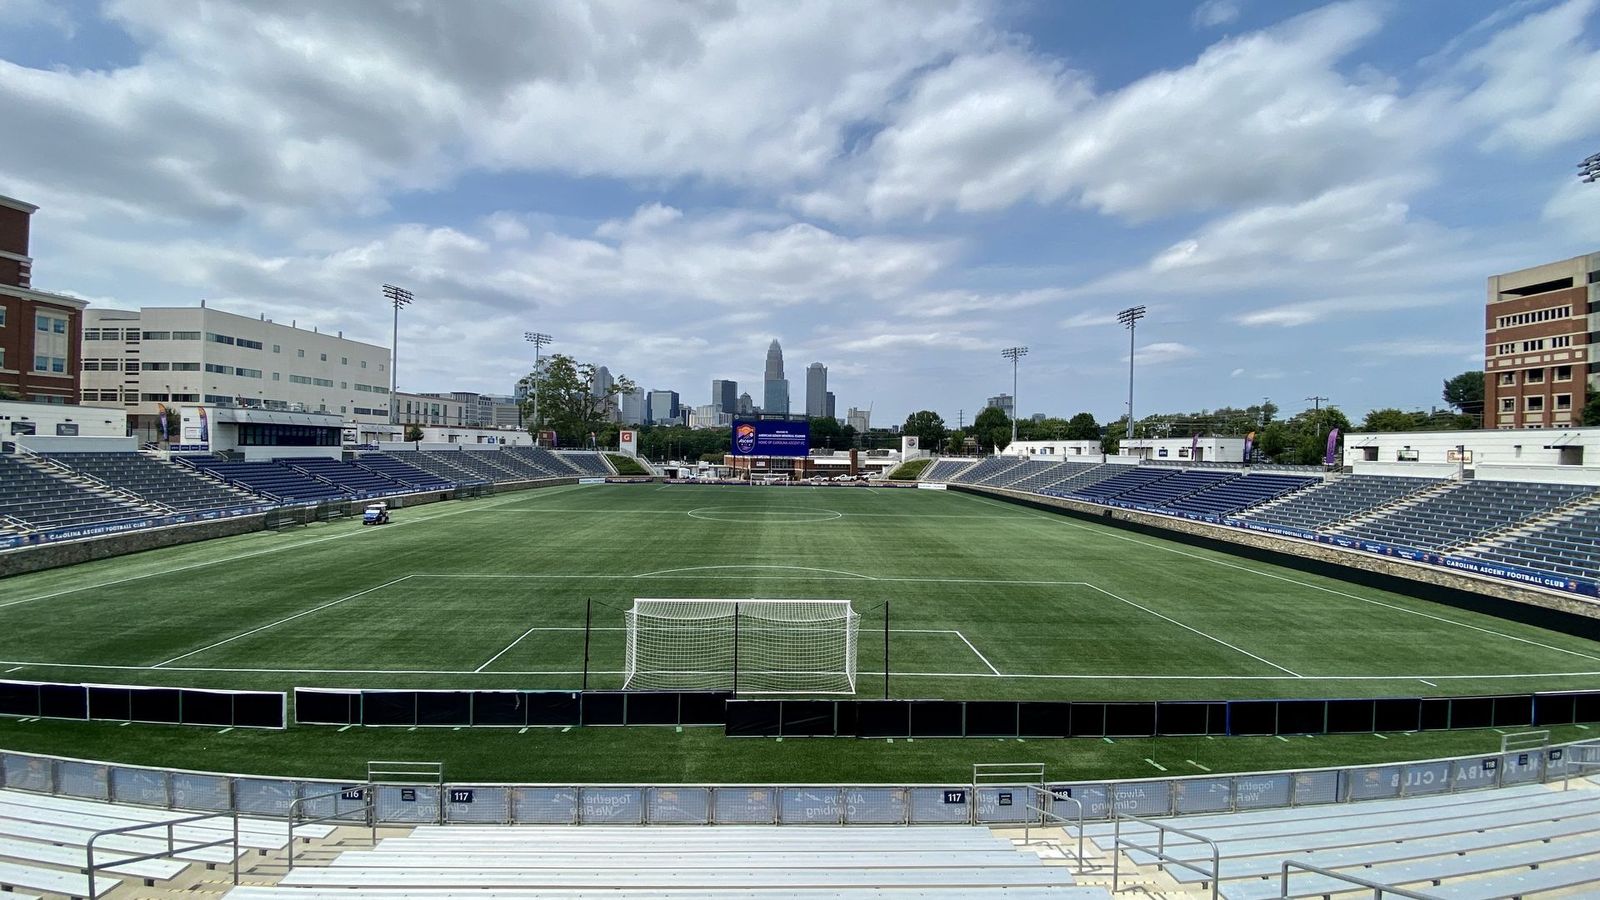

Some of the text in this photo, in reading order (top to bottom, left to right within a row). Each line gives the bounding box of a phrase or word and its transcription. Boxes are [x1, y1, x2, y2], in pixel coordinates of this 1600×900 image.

[82, 527, 105, 535] ASCENT
[1446, 559, 1565, 588] CAROLINA ASCENT FOOTBALL CLUB
[455, 792, 469, 801] 117
[948, 793, 962, 802] 117
